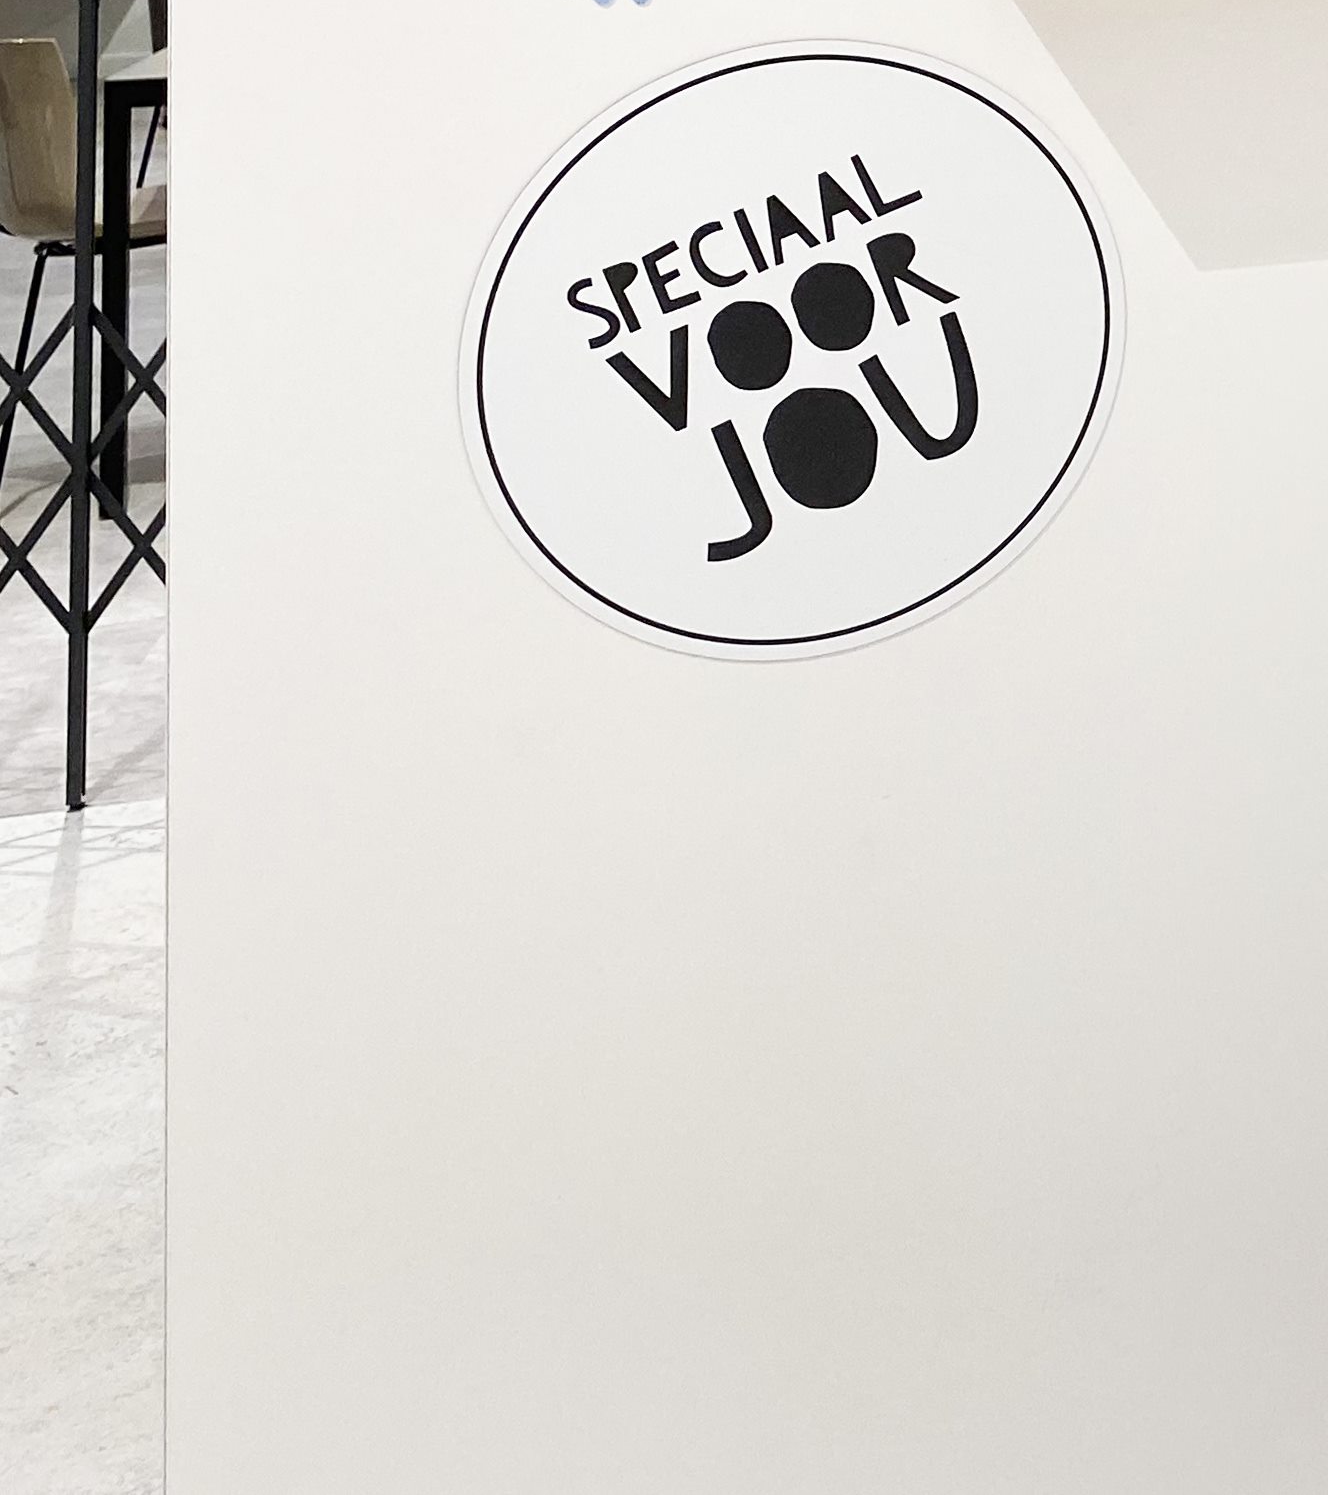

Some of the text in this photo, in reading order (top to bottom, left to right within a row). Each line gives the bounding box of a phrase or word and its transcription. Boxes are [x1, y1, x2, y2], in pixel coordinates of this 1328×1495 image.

[567, 154, 922, 350] SPECIAAL
[605, 232, 961, 432] VOOR
[707, 311, 979, 562] JOU
